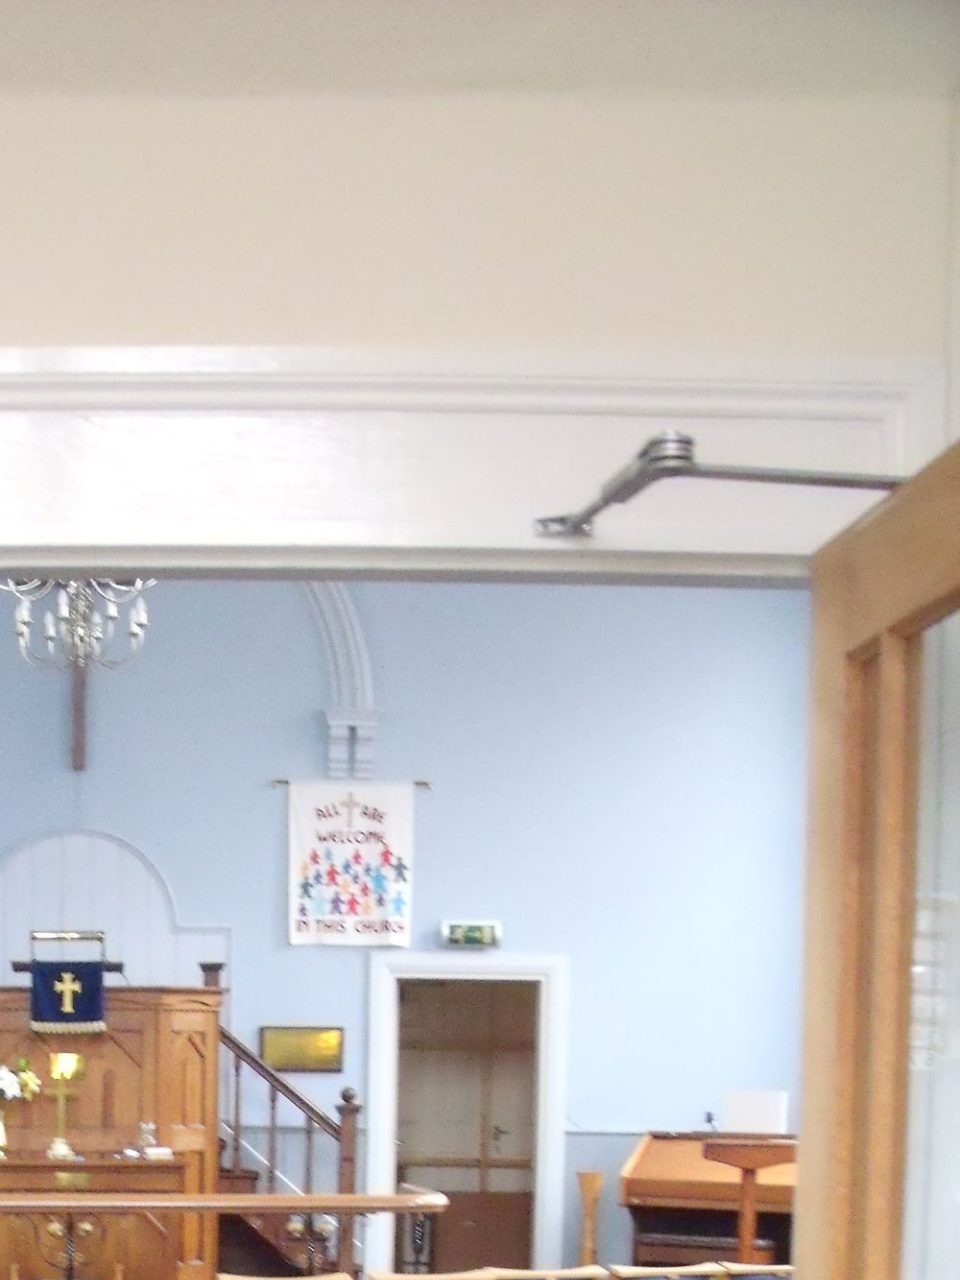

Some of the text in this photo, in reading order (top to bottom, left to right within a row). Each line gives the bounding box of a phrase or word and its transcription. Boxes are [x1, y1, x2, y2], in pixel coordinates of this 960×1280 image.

[315, 803, 386, 824] ALL ARE
[315, 830, 384, 844] WELCOME
[296, 918, 405, 934] IN THIS CHURCH
